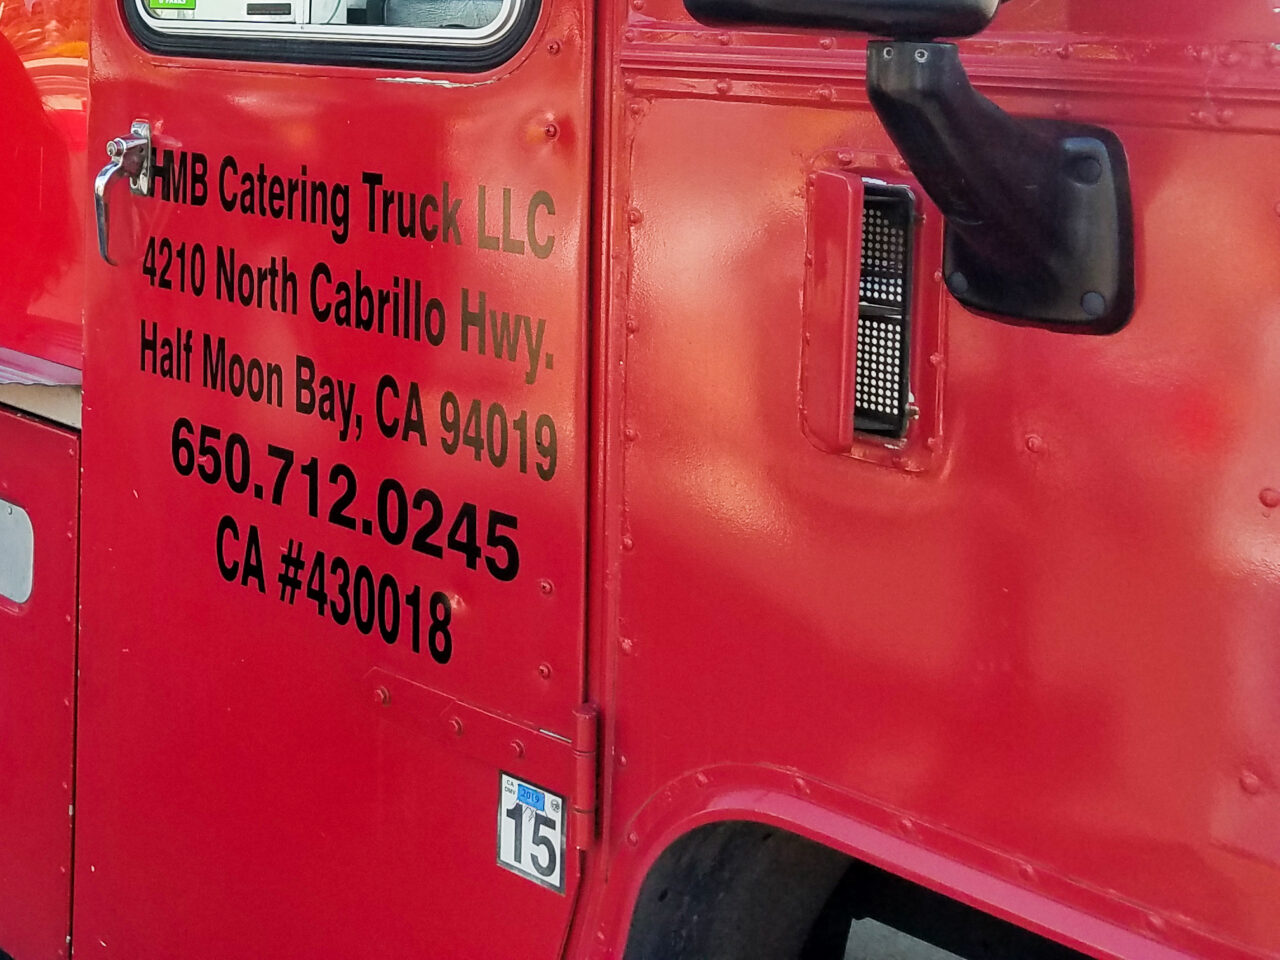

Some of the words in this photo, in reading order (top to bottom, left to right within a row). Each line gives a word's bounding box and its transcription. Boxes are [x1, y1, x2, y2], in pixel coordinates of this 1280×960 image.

[149, 147, 208, 206] HMB
[219, 155, 351, 245] Catering
[362, 171, 465, 247] Truck
[476, 183, 557, 260] LLC
[142, 236, 206, 298] 4210
[216, 245, 298, 316] North
[310, 262, 447, 348] Cabrillo
[460, 287, 555, 386] Hwy.
[140, 319, 193, 378] Half
[202, 333, 284, 409] Moon
[296, 354, 364, 443] Bay,
[376, 374, 429, 448] CA
[440, 390, 558, 482] 94019
[171, 416, 521, 583] 650.712.0245
[217, 515, 267, 596] CA
[277, 537, 454, 666] #430018
[504, 786, 516, 796] DMV
[506, 779, 515, 788] CA
[521, 788, 540, 804] 2019
[506, 802, 557, 878] 15
